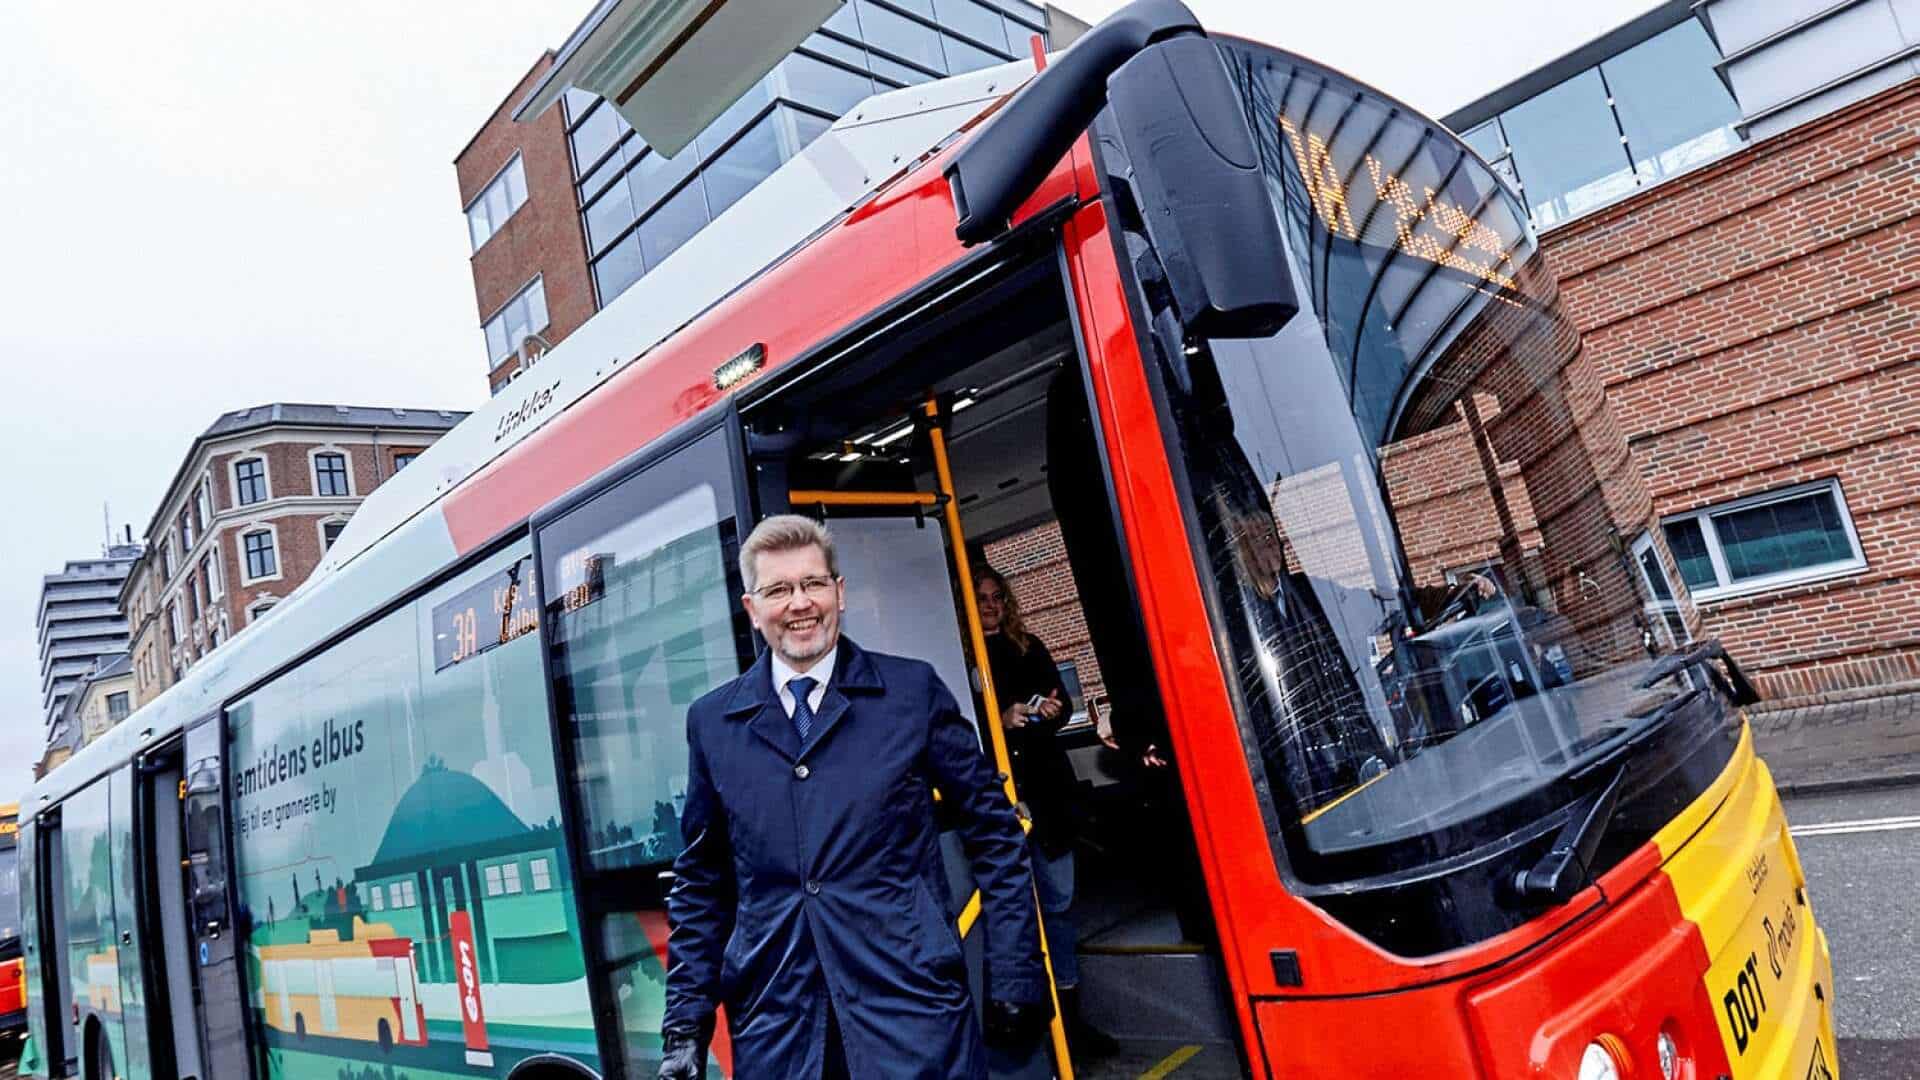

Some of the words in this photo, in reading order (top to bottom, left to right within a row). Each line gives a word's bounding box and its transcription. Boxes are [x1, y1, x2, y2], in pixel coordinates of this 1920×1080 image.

[453, 608, 476, 662] 3A
[312, 717, 364, 768] elbus
[261, 808, 273, 827] en
[275, 792, 320, 830] grønnere
[322, 781, 337, 815] by
[1723, 951, 1767, 1057] DOT
